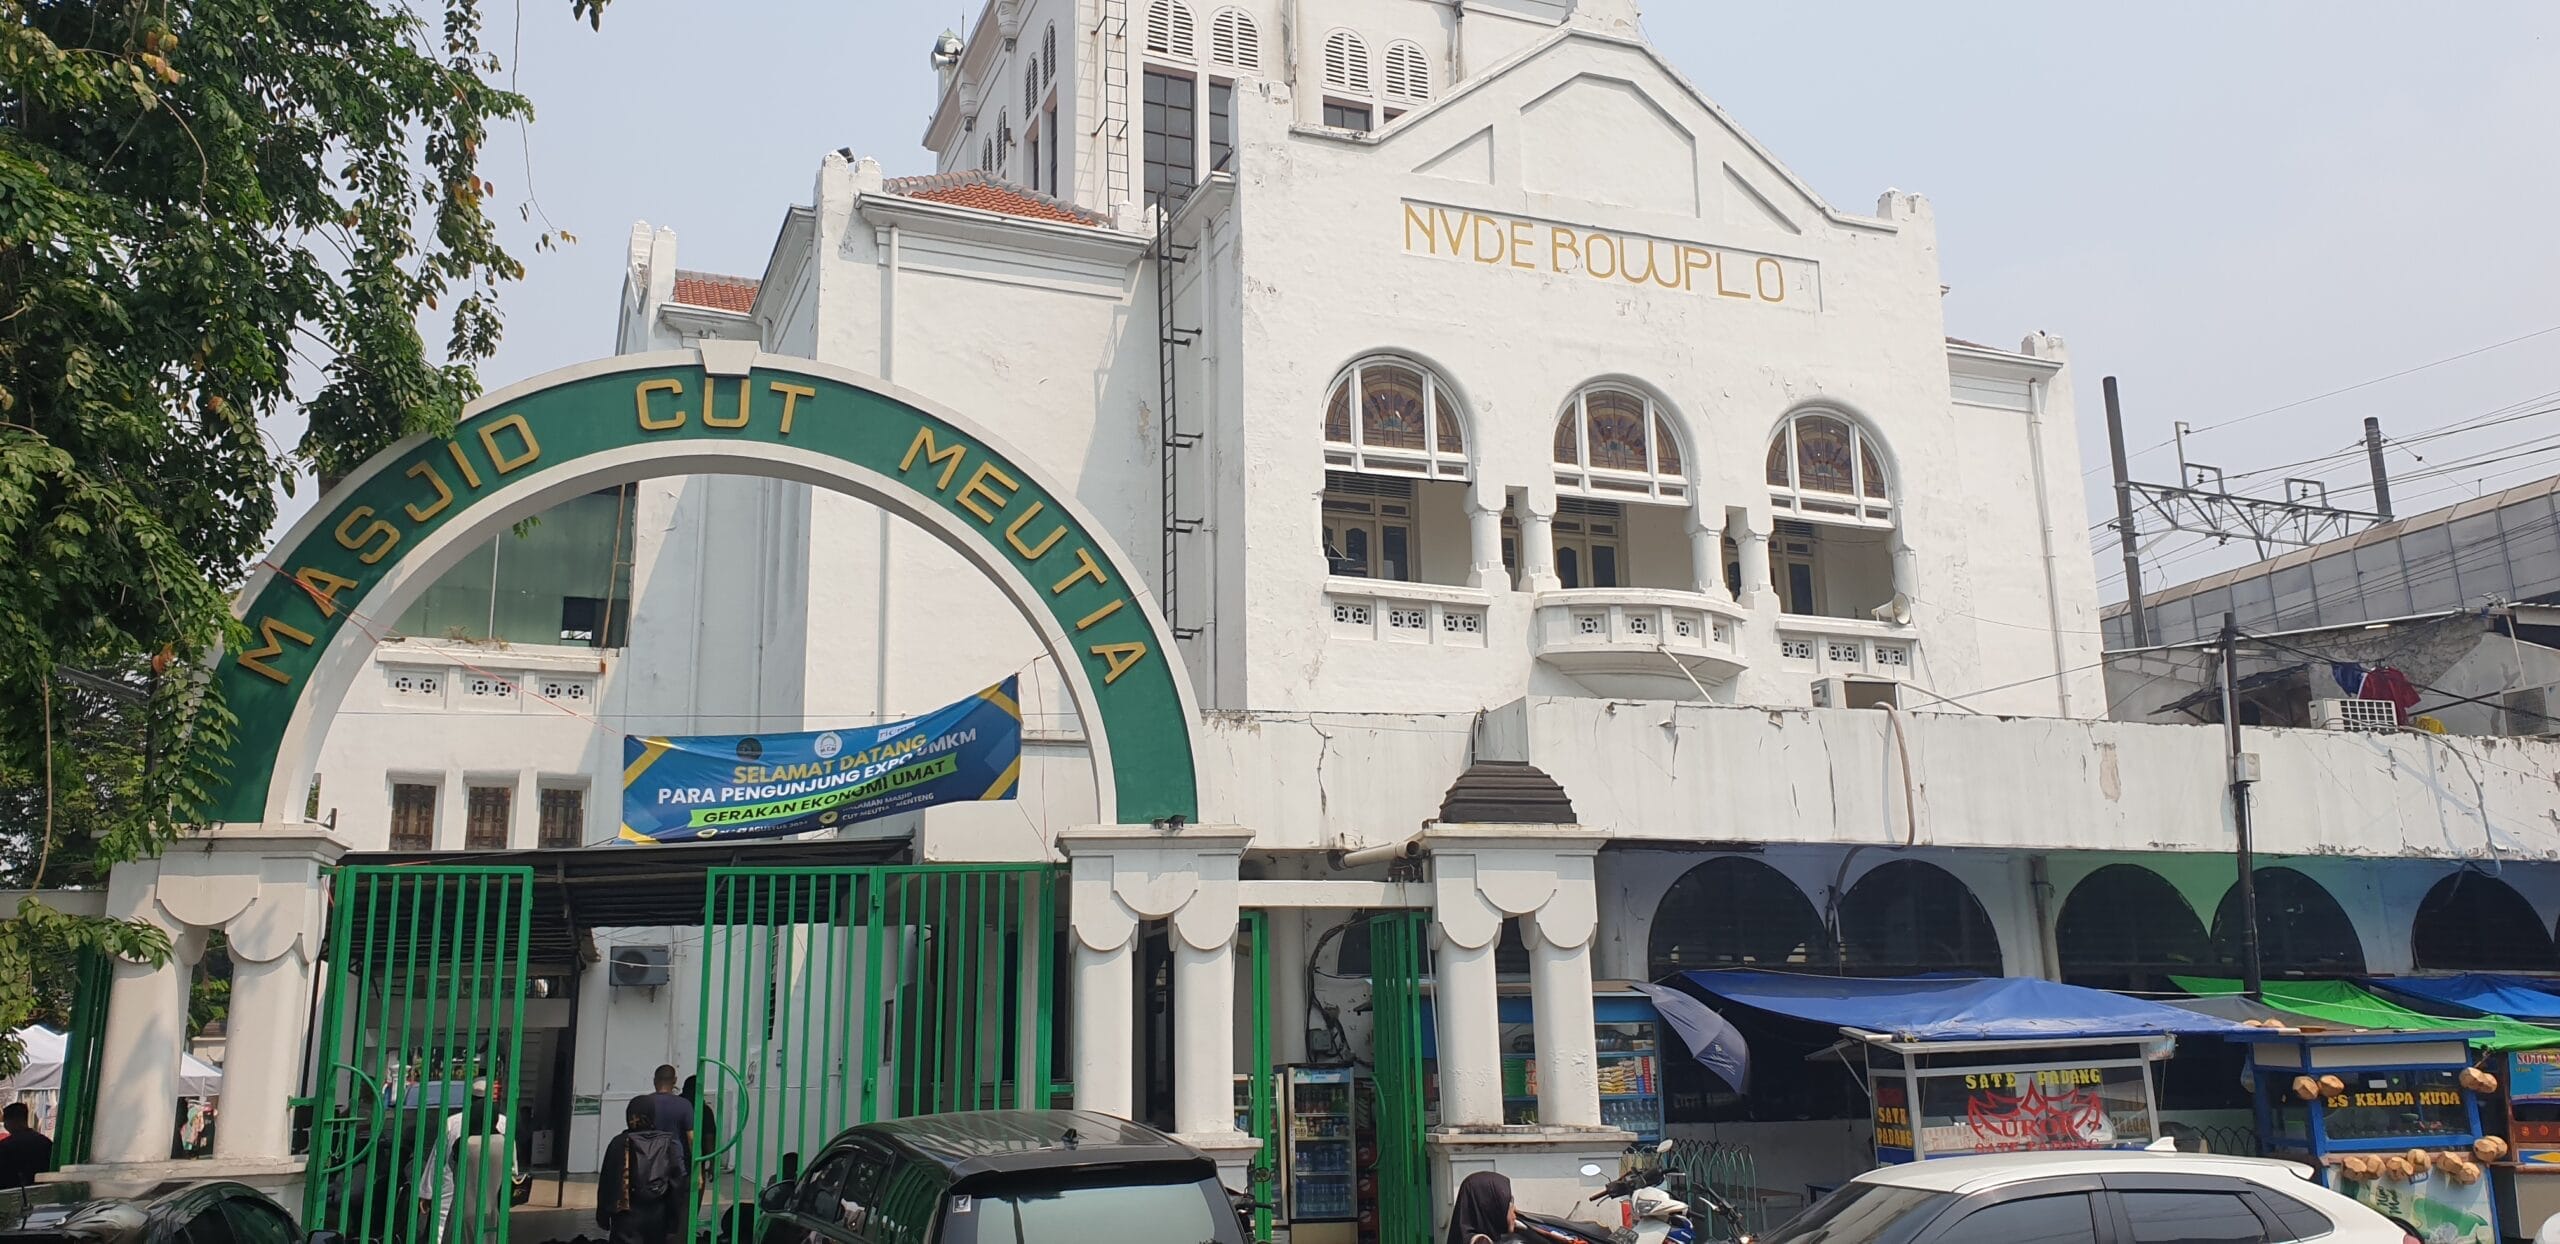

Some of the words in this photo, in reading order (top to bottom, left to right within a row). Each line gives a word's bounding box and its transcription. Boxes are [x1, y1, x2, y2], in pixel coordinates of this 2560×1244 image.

[237, 414, 540, 685] MASJID
[636, 378, 816, 434] CUT
[899, 426, 1147, 684] MEUTIA
[657, 786, 716, 805] PARA
[720, 769, 860, 802] PENGUNJUNG
[863, 752, 913, 778] EXPO
[917, 728, 977, 757] UMKM
[733, 760, 835, 784] SELAMAT
[840, 734, 927, 771] DATANG
[703, 802, 797, 822] GERAKAN
[800, 777, 889, 811] EKONOMI
[892, 760, 946, 786] UMAT
[1966, 1072, 2016, 1089] SATE
[2037, 1068, 2100, 1086] PADANG
[2517, 1053, 2549, 1064] SOTO
[2355, 1092, 2415, 1107] KELAPA
[2419, 1091, 2461, 1105] MUDA
